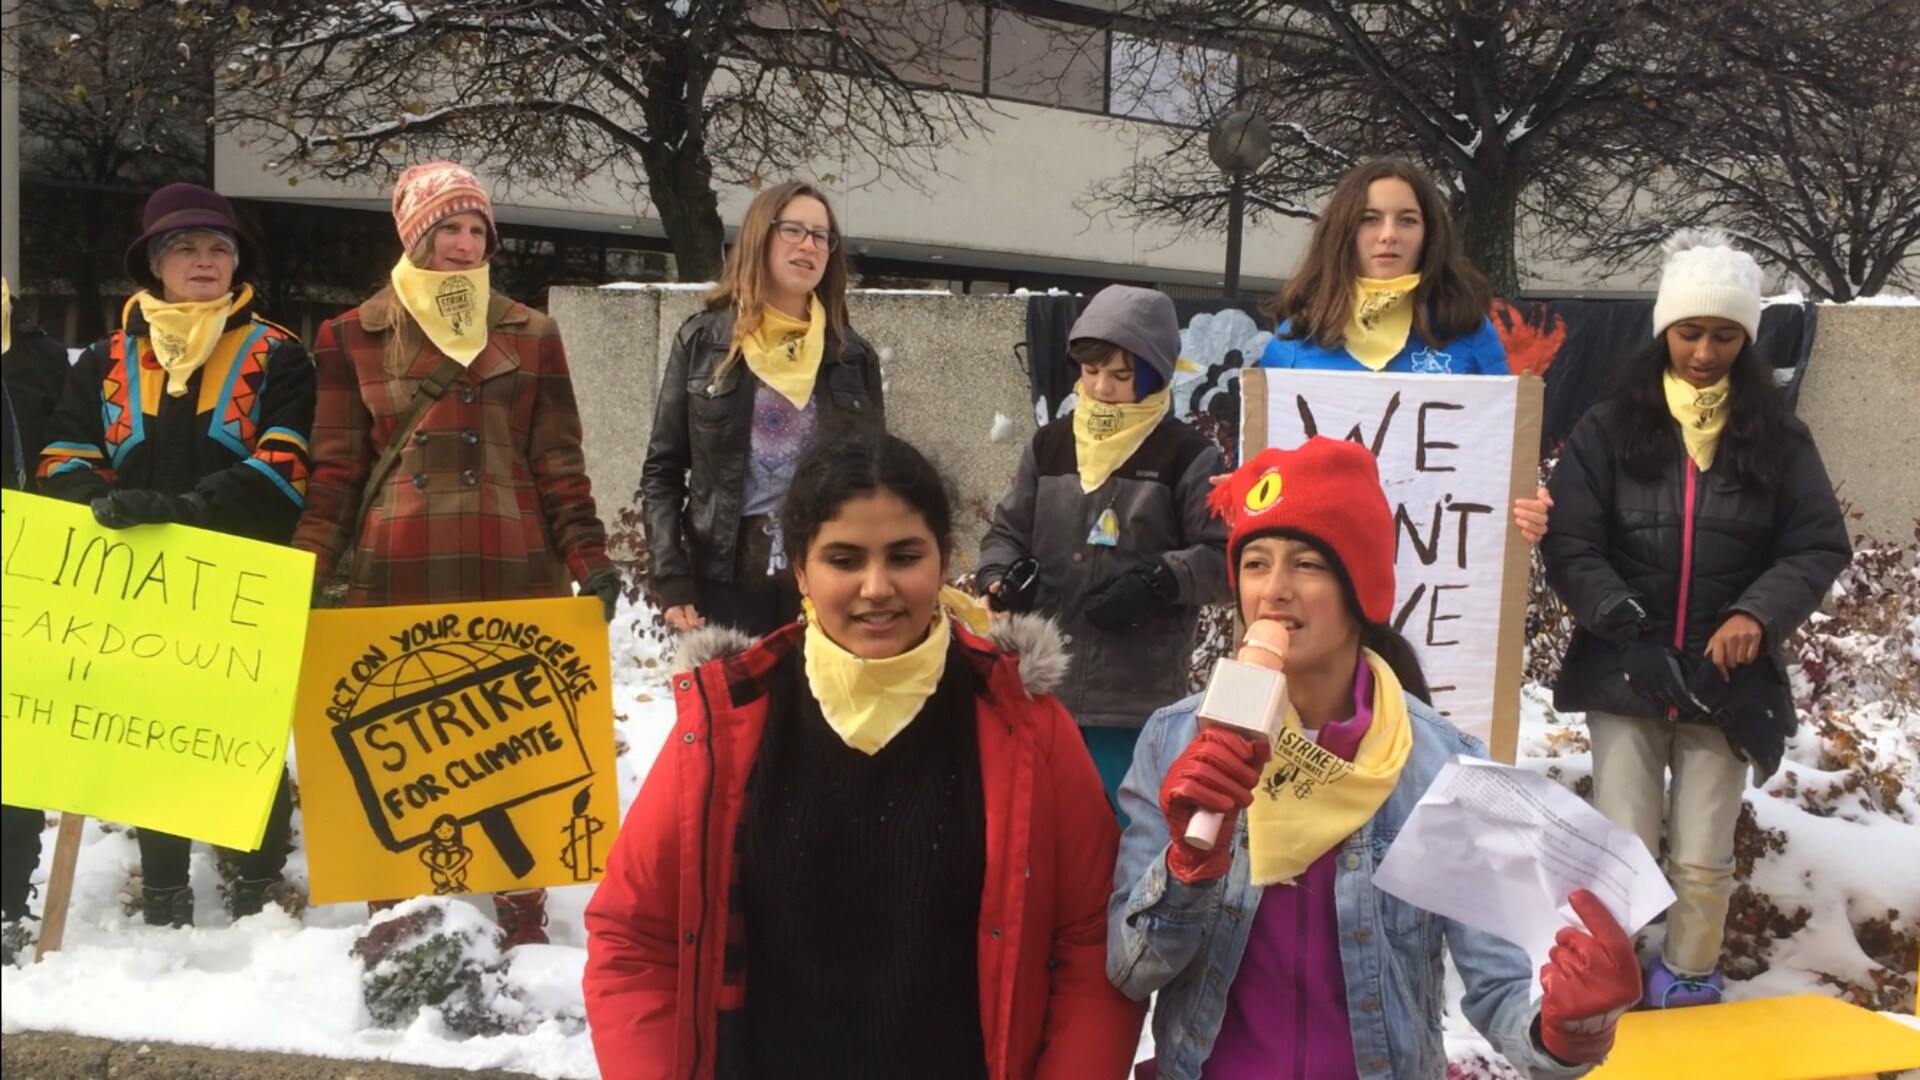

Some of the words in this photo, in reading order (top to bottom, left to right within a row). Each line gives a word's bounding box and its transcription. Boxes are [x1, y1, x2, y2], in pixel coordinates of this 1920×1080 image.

[1, 509, 268, 627] LIMATE
[325, 677, 358, 723] ACT
[352, 643, 387, 682] ON
[390, 614, 461, 652] YOUR
[467, 616, 598, 702] CONSCIENCE
[70, 704, 275, 775] EMERGENCY
[364, 667, 552, 772] STRIKE
[1282, 732, 1334, 769] STRIKE
[1294, 755, 1324, 778] CLIMATE
[383, 774, 449, 820] FOR
[445, 721, 563, 788] CLIMATE
